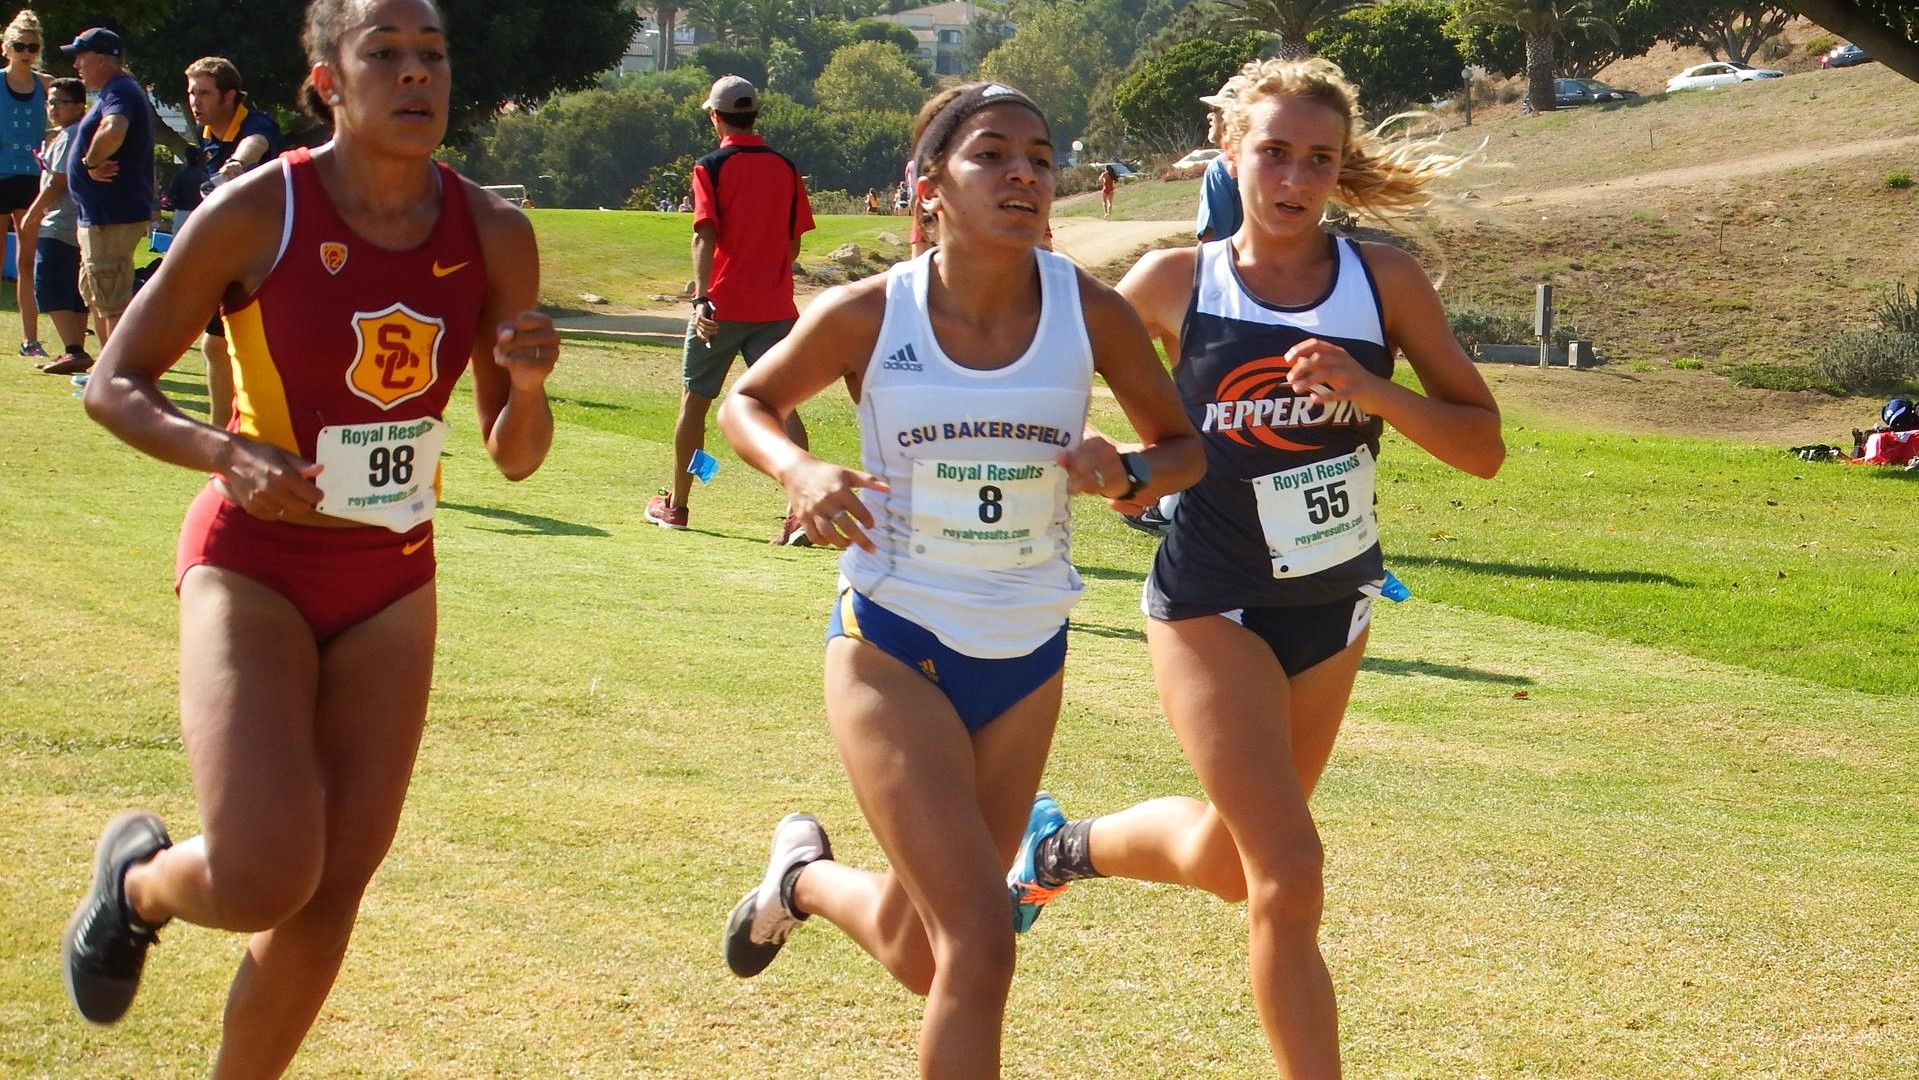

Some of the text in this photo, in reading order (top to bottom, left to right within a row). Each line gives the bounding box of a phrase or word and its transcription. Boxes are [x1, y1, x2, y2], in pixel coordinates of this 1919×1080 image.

[883, 361, 924, 372] adidas
[341, 426, 383, 446] Royal
[897, 421, 1071, 447] CSU BAKERSFIELD
[369, 445, 415, 488] 98
[936, 463, 1044, 482] Royal Results
[1273, 468, 1314, 491] Royal
[978, 485, 1003, 524] 8
[1303, 480, 1350, 524] 55
[943, 528, 1030, 540] royalresults.com
